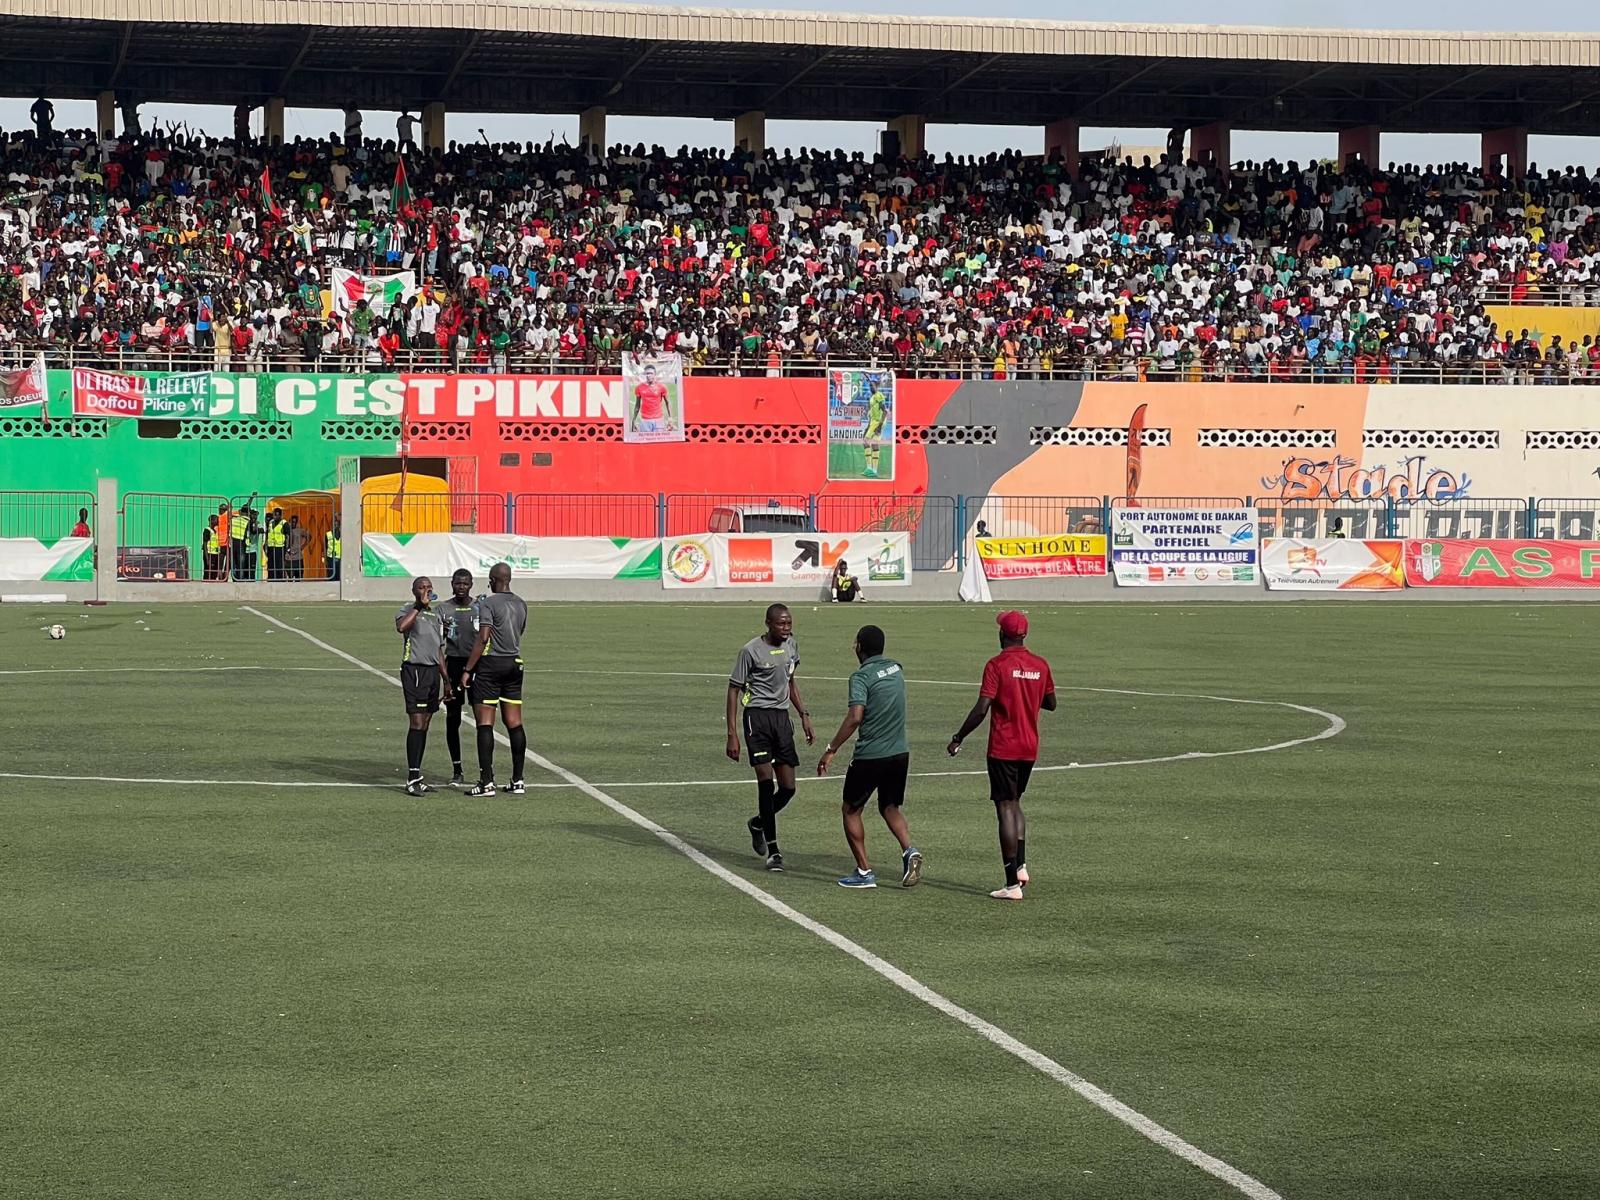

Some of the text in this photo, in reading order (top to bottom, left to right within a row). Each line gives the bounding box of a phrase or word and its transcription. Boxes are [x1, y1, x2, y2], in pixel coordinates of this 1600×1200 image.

[76, 371, 130, 393] ULTRAS
[134, 377, 151, 394] LA
[275, 378, 446, 416] C'EST
[87, 394, 205, 412] Doffou Pikine Yi
[829, 429, 863, 439] LANDING
[1281, 455, 1459, 506] Stade
[1120, 512, 1248, 521] PORT AUTONOME DE DAKAR
[1142, 525, 1223, 534] PARTENAIRE
[983, 539, 1092, 556] SUNHOME
[1154, 537, 1211, 547] OFFICIEL
[1121, 552, 1249, 562] DE LA COUPE DE LA LIGUE
[1459, 547, 1554, 578] AS
[1008, 562, 1042, 574] VOTRE
[731, 571, 768, 581] orange
[791, 572, 820, 582] Orange
